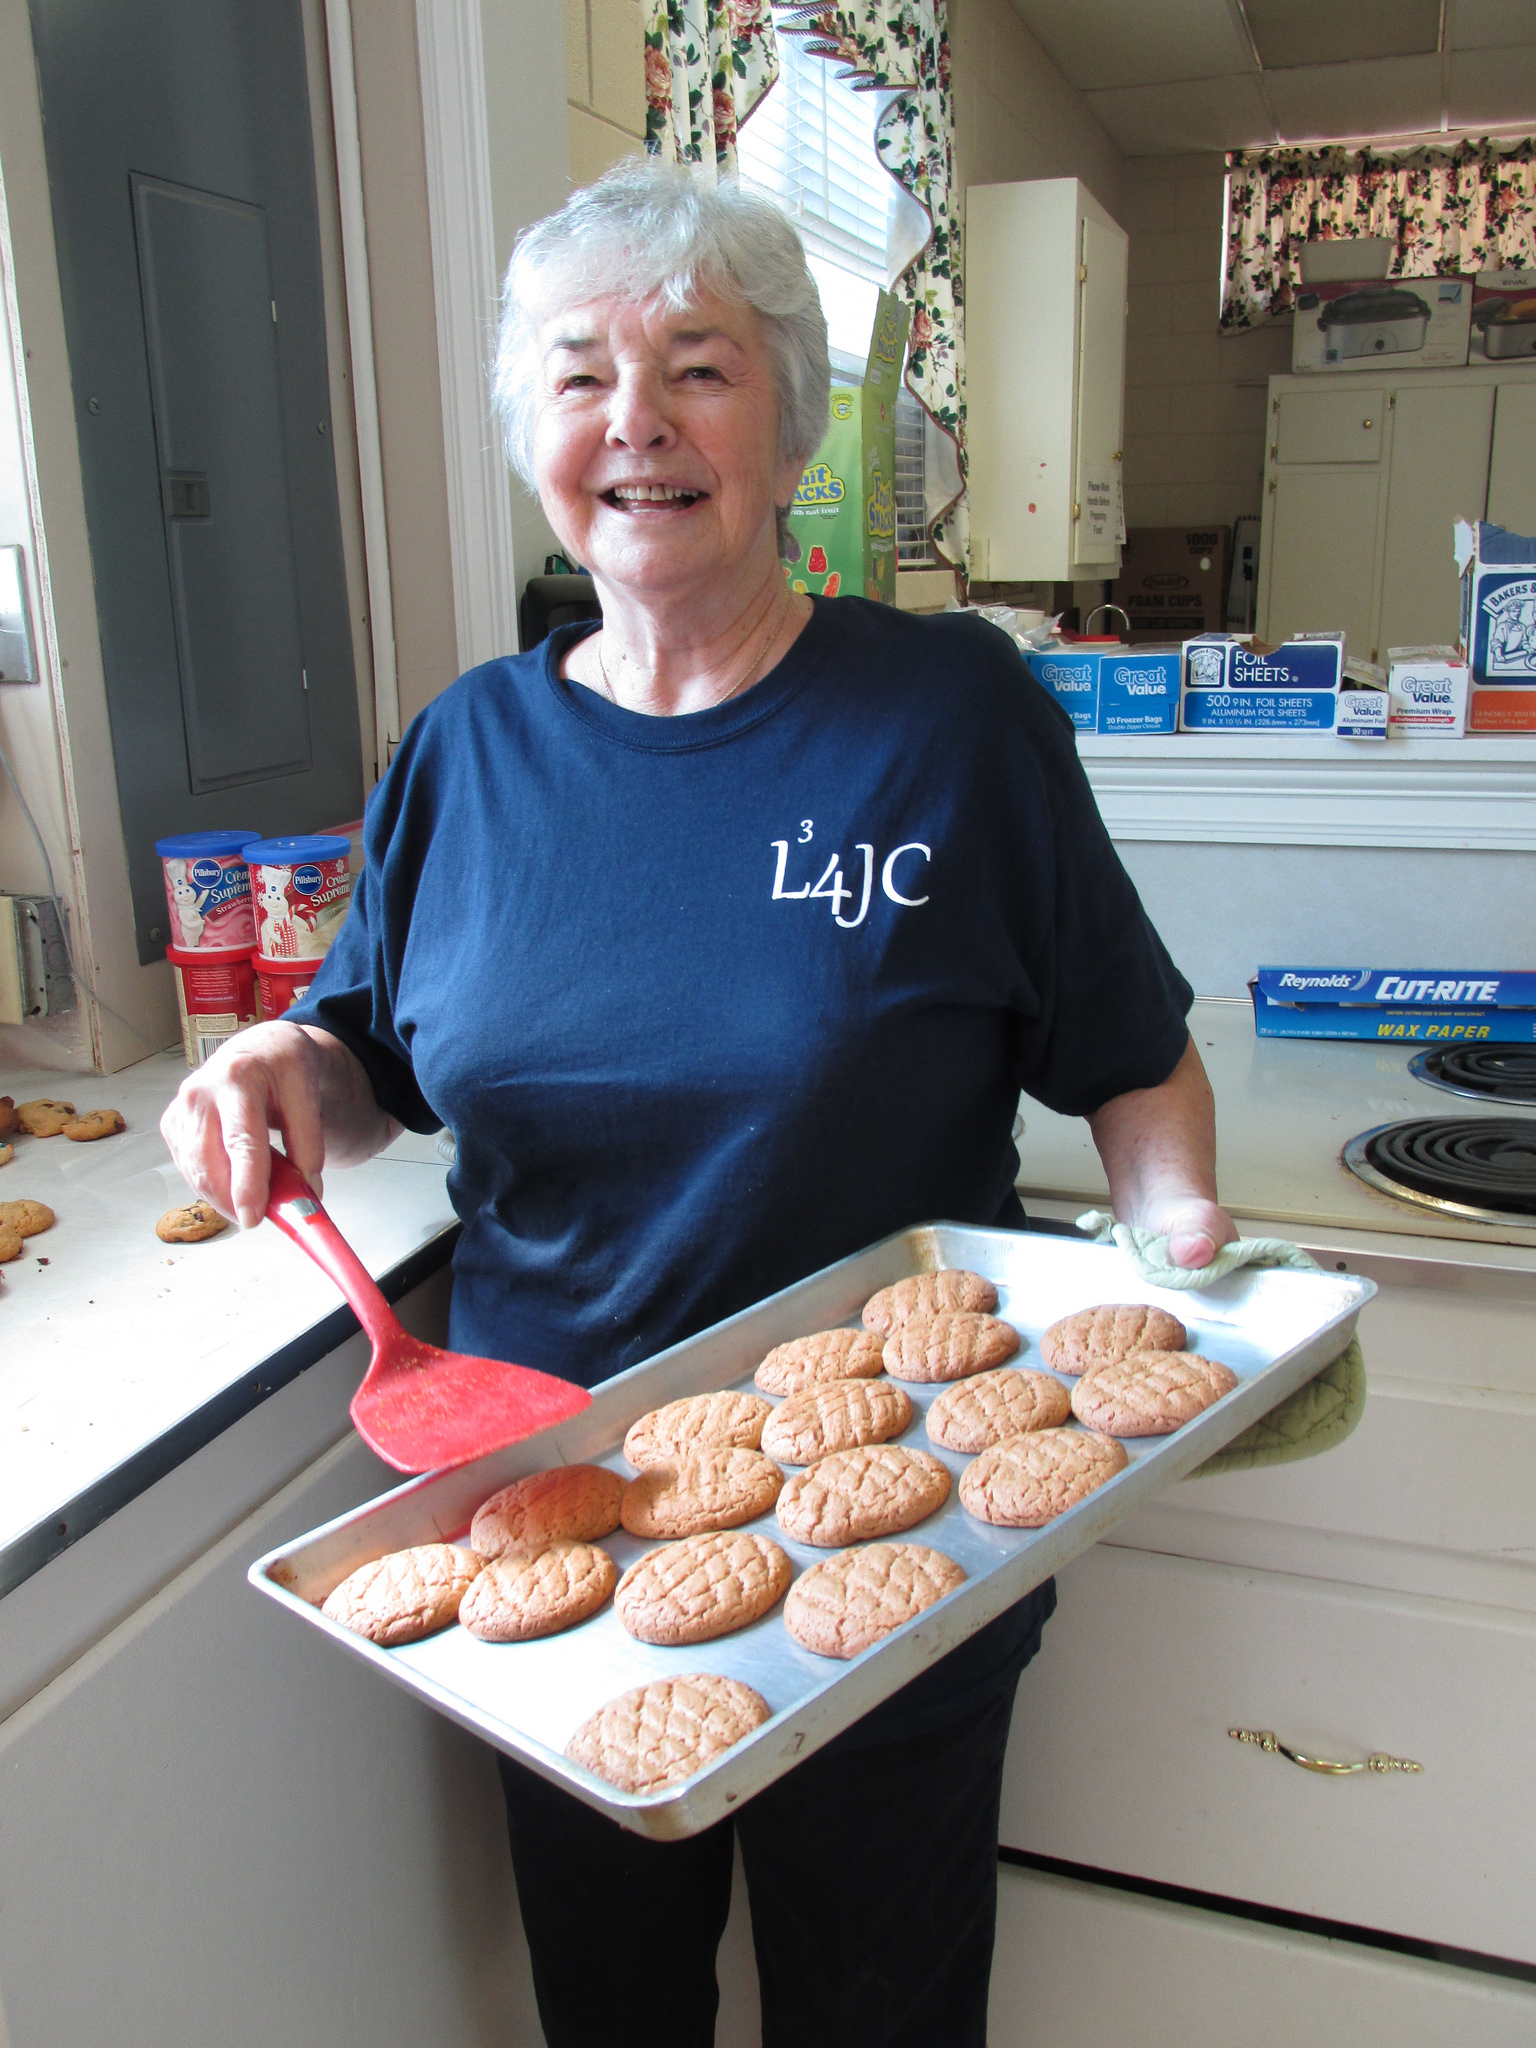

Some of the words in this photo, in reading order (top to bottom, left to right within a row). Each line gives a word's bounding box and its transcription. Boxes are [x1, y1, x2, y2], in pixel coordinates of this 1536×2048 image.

[800, 466, 827, 485] uit
[795, 481, 842, 502] ACKS
[1185, 533, 1218, 546] 1000
[1128, 595, 1164, 607] FOAM
[1168, 595, 1202, 607] CUPS
[1489, 584, 1528, 607] BAKERS
[1235, 651, 1268, 666] FOIL
[1042, 664, 1092, 682] Great
[1114, 667, 1167, 686] Great
[1234, 667, 1289, 682] SHEETS
[1054, 682, 1092, 692] Value
[1127, 684, 1167, 695] Value
[1401, 676, 1452, 694] Great
[1205, 694, 1231, 707] 500
[1232, 699, 1239, 707] 9
[1256, 699, 1276, 707] FOIL
[1278, 699, 1313, 708] SHEETS
[1345, 694, 1383, 709] Great
[1412, 693, 1452, 703] Value
[1074, 712, 1092, 720] Bags
[1211, 709, 1256, 717] ALUMINUM
[1258, 709, 1276, 717] FOIL
[1277, 709, 1307, 717] SHEETS
[1353, 707, 1383, 717] Value
[1396, 707, 1431, 715] Premium
[1431, 707, 1452, 716] Wrap
[1106, 717, 1115, 725] 30
[1116, 716, 1144, 724] Freezer
[1144, 715, 1163, 724] Bags
[194, 868, 221, 878] Pillsbury
[225, 870, 251, 885] Crea
[294, 875, 322, 886] Pillsbury
[210, 882, 252, 904] Suprem
[1278, 972, 1352, 991] Reynolds
[1374, 976, 1500, 1001] CUT-RITE
[1377, 1023, 1420, 1037] WAX
[1425, 1025, 1491, 1038] PAPER
